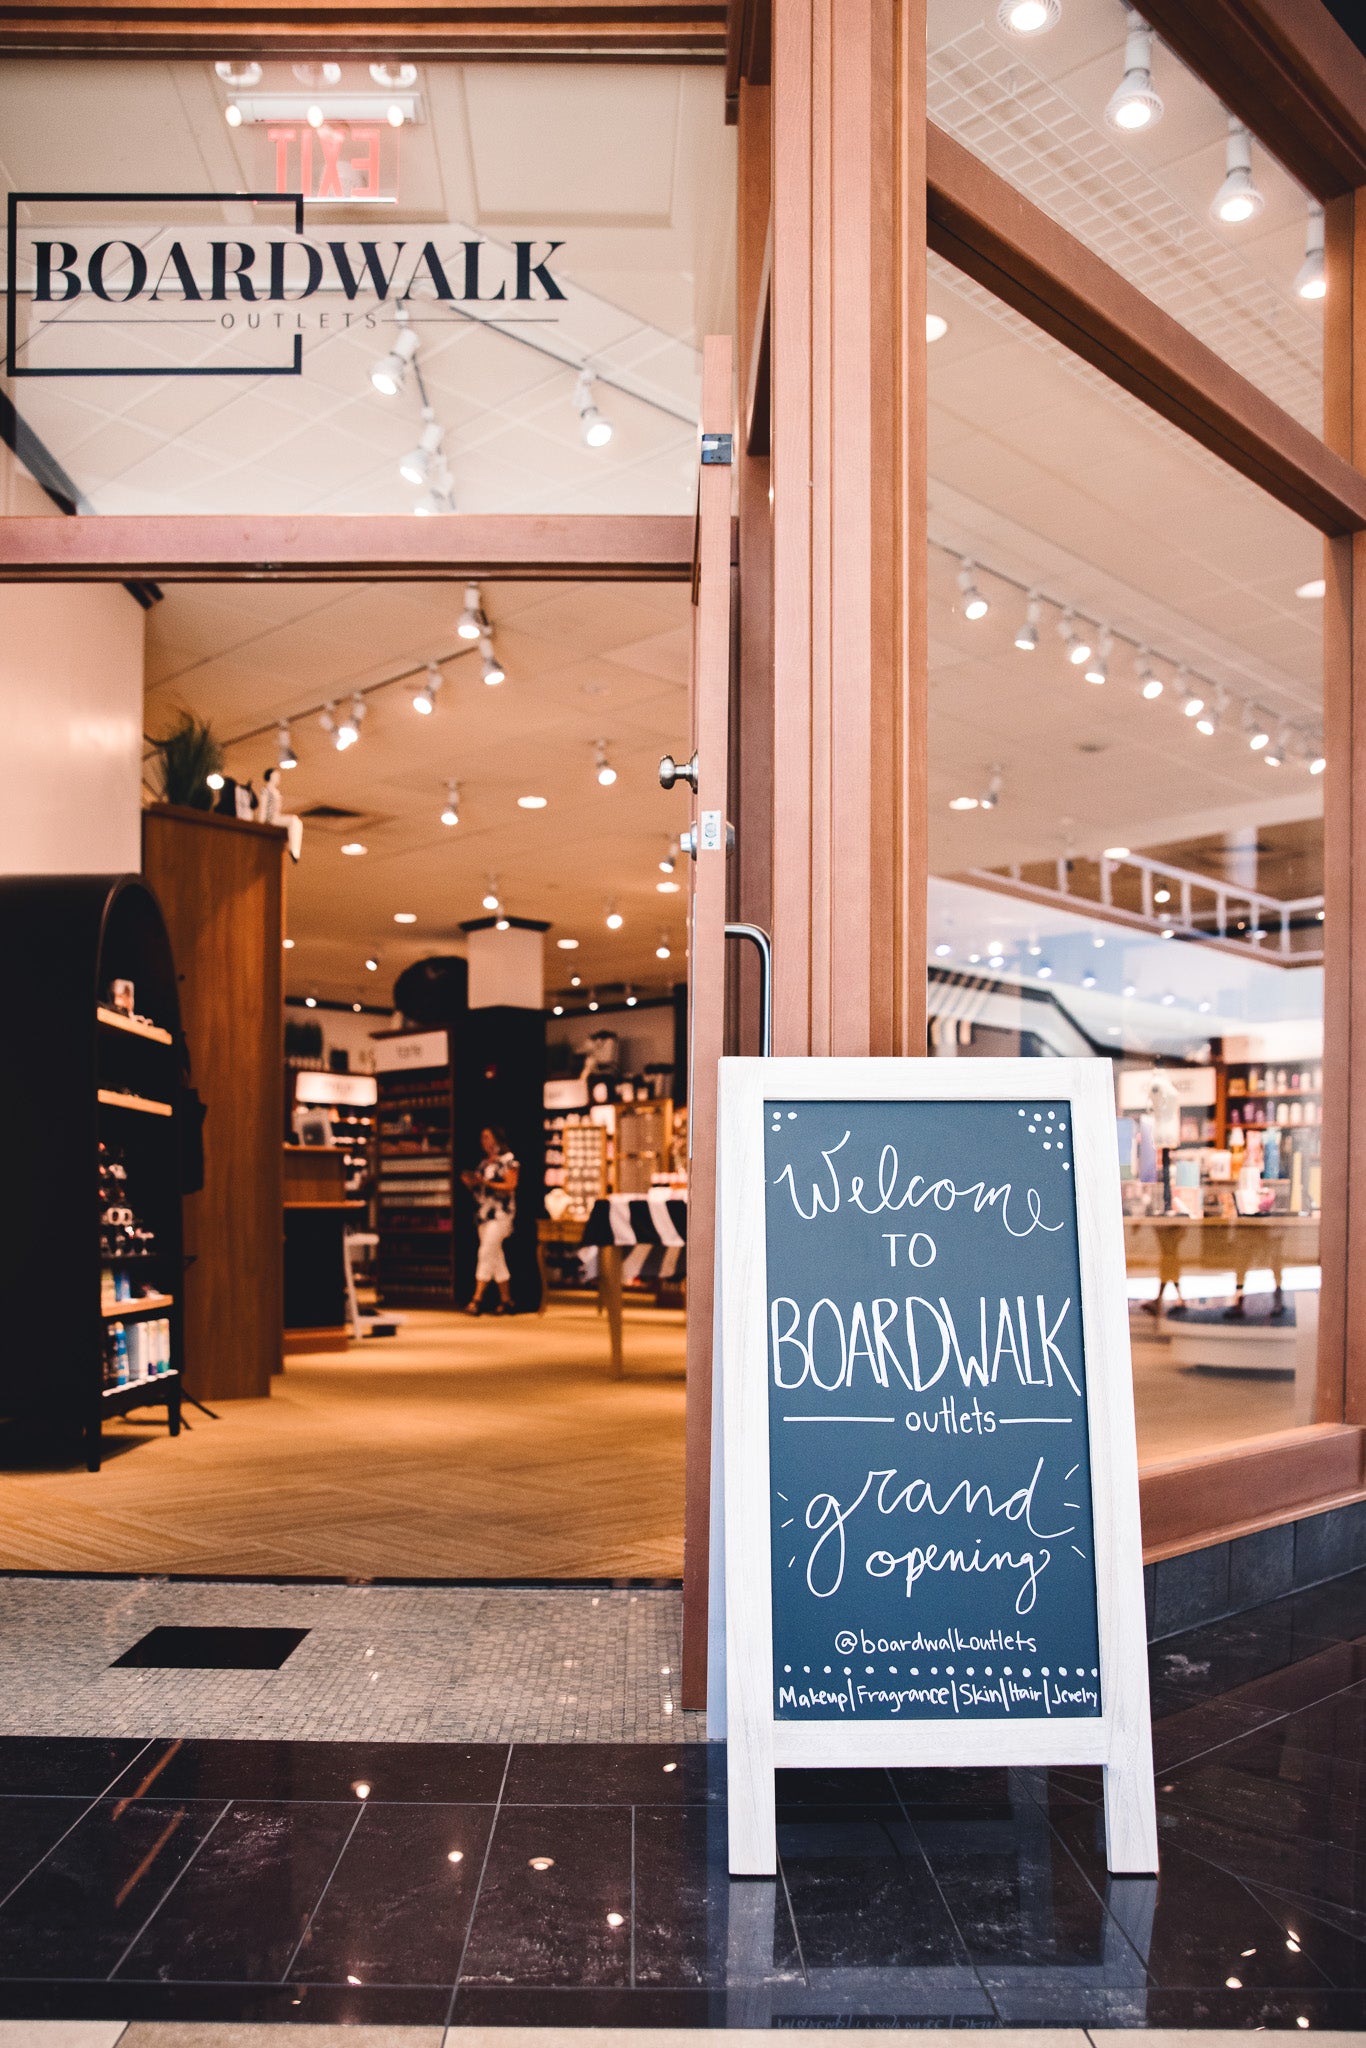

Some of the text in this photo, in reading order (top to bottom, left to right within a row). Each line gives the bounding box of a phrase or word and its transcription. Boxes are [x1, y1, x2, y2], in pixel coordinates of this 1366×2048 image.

[31, 240, 568, 302] BOARDWALK
[220, 313, 377, 329] OUTLETS
[773, 1130, 1064, 1237] Welcome
[881, 1232, 937, 1268] TO
[771, 1294, 1082, 1397] BOARDWALK
[905, 1396, 997, 1435] outlets
[805, 1457, 1075, 1598] grand
[865, 1538, 1051, 1615] opening
[834, 1628, 1037, 1655] @boardwalkoutlets
[779, 1686, 849, 1712] Makeup
[857, 1685, 949, 1713] Fragrance
[959, 1684, 1002, 1704] Skin
